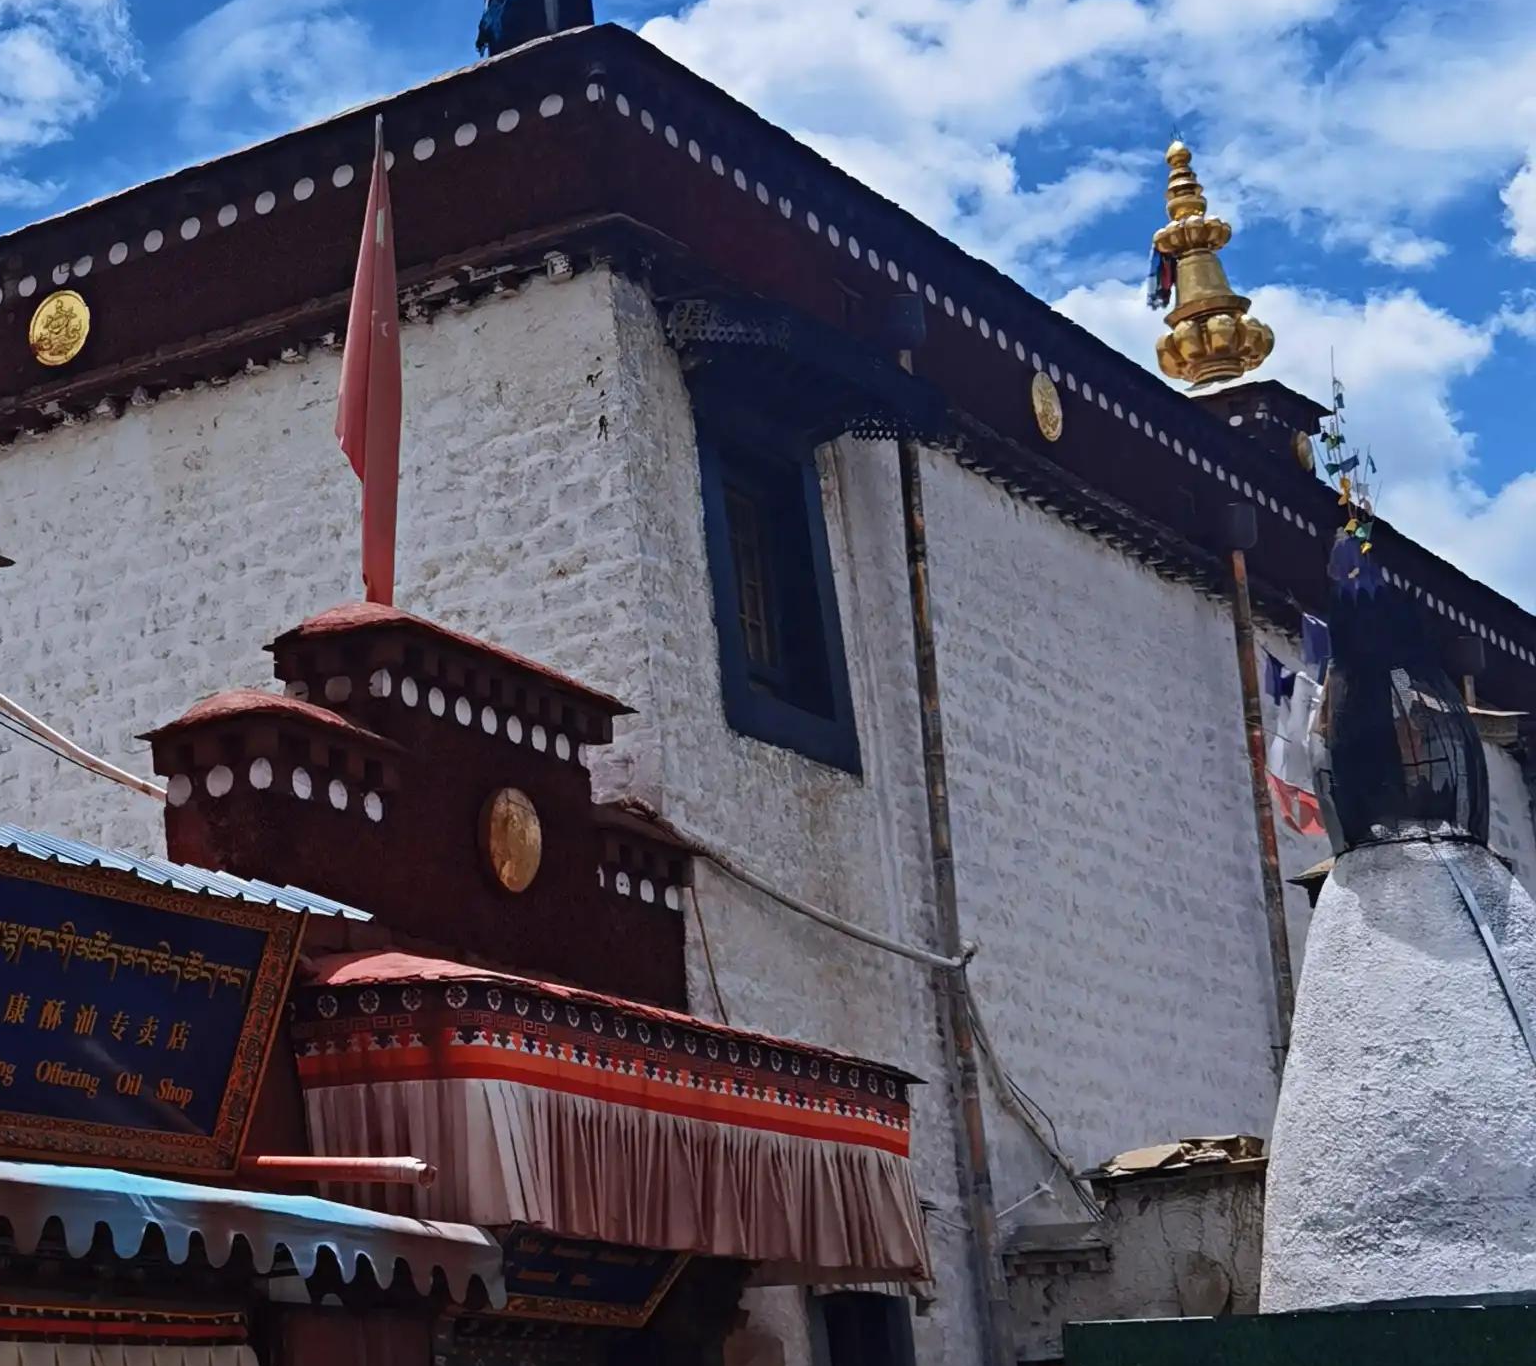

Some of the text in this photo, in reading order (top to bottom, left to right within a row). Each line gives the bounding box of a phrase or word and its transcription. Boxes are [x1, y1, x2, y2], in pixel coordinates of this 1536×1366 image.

[35, 1059, 101, 1099] Offering
[116, 1071, 142, 1097] Oil
[156, 1077, 193, 1109] Shop
